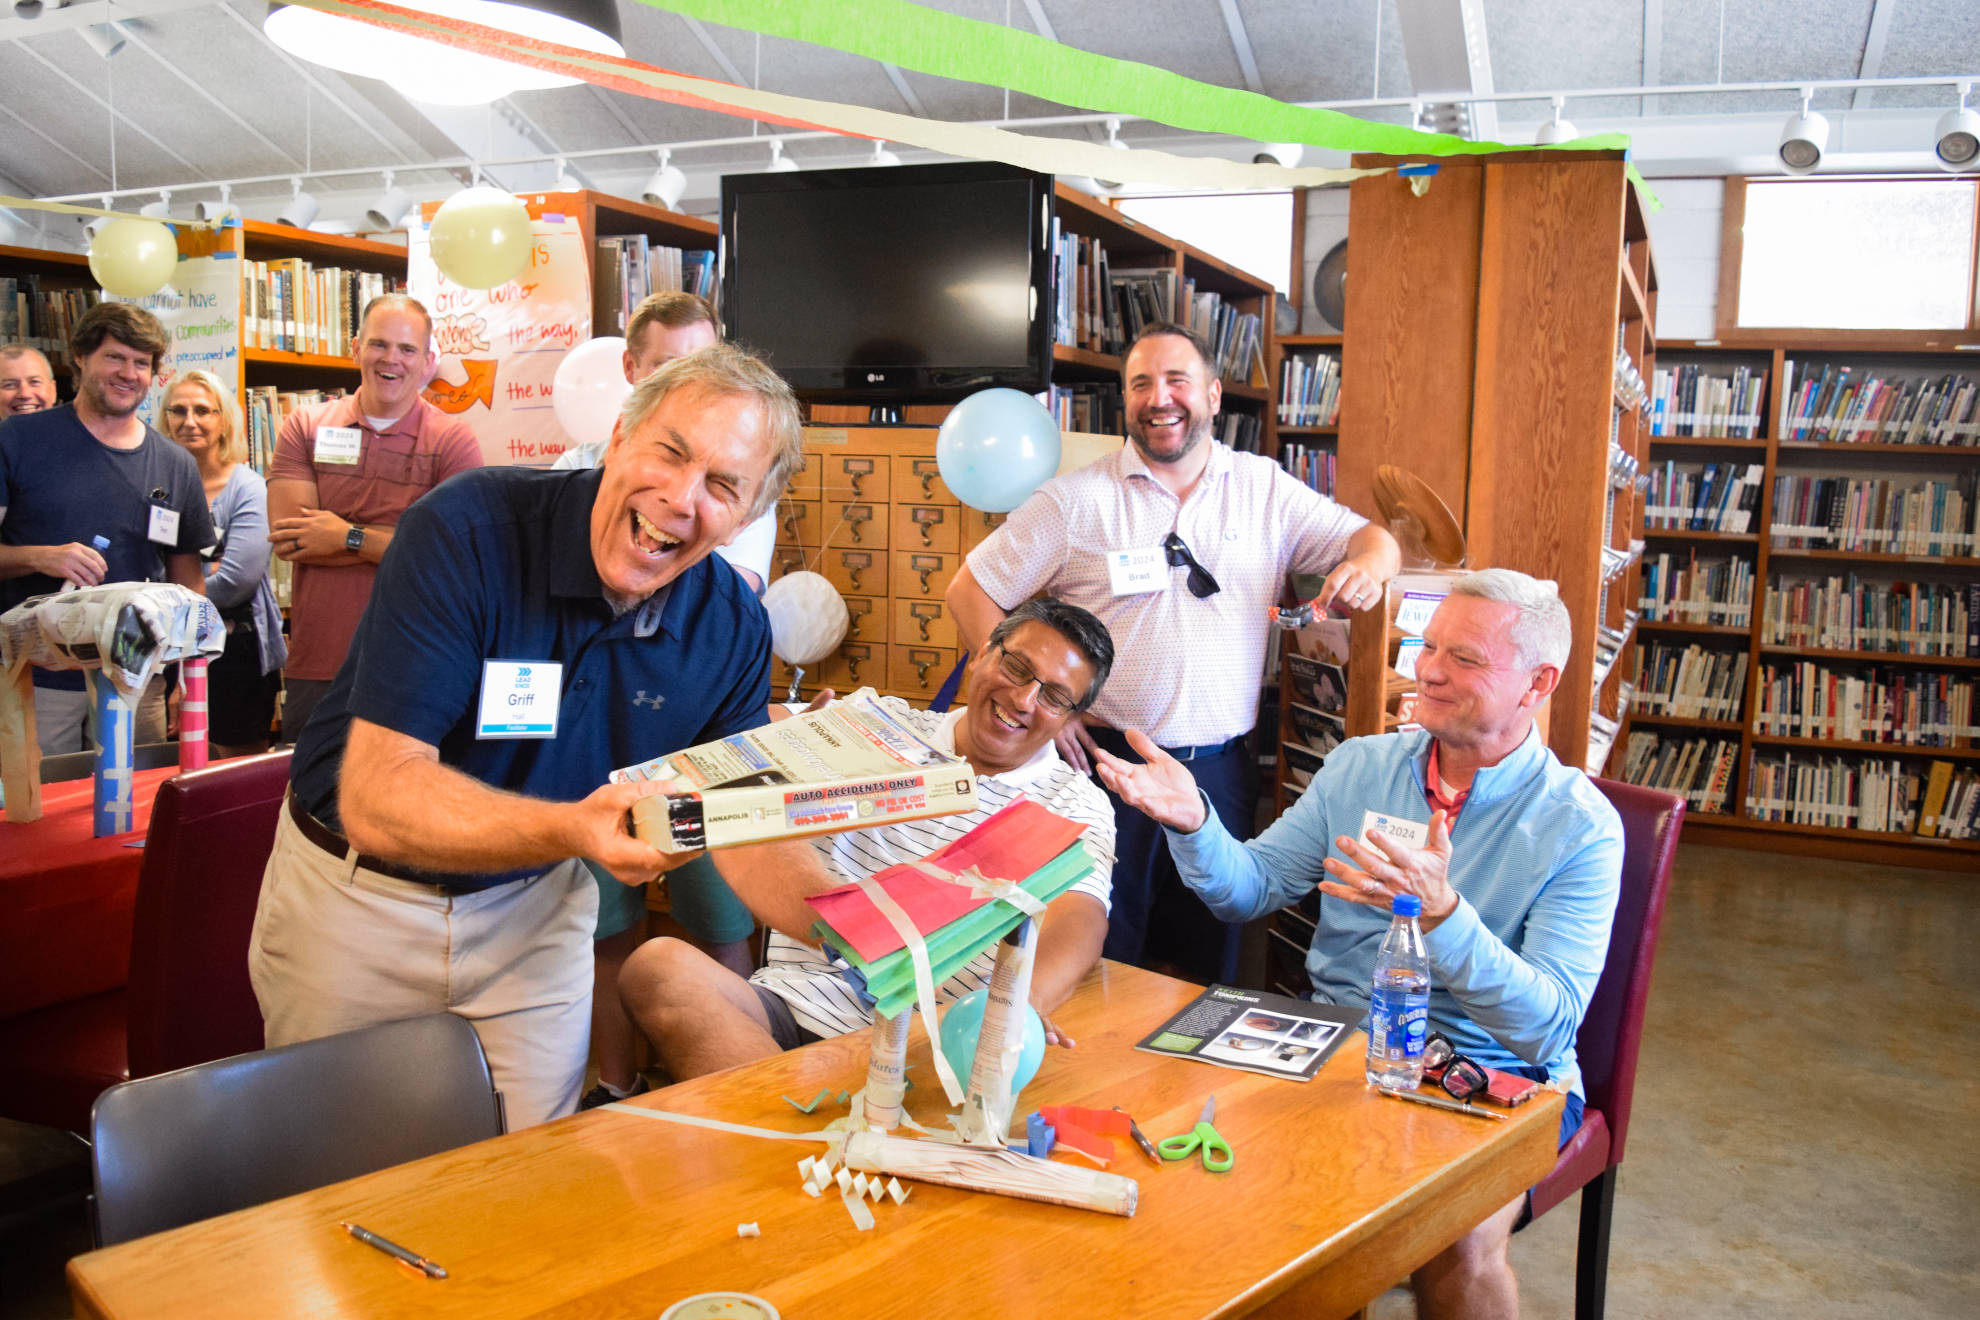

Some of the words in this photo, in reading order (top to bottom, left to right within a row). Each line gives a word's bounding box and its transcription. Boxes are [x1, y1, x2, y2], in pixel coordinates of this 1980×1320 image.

[189, 287, 217, 308] have
[435, 288, 473, 313] one
[488, 282, 540, 305] who
[176, 316, 236, 341] communities
[508, 323, 534, 346] the
[176, 346, 224, 365] preoccupied
[506, 382, 534, 401] the
[507, 438, 537, 459] the
[1128, 572, 1151, 582] Brad
[508, 693, 536, 706] Griff
[807, 720, 843, 748] ANNAPOLIS
[793, 790, 824, 802] AUTO
[828, 782, 885, 798] ACCIDENTS
[889, 778, 917, 791] ONLY
[707, 812, 750, 823] ANNAPOLIS
[1388, 824, 1416, 840] 2024
